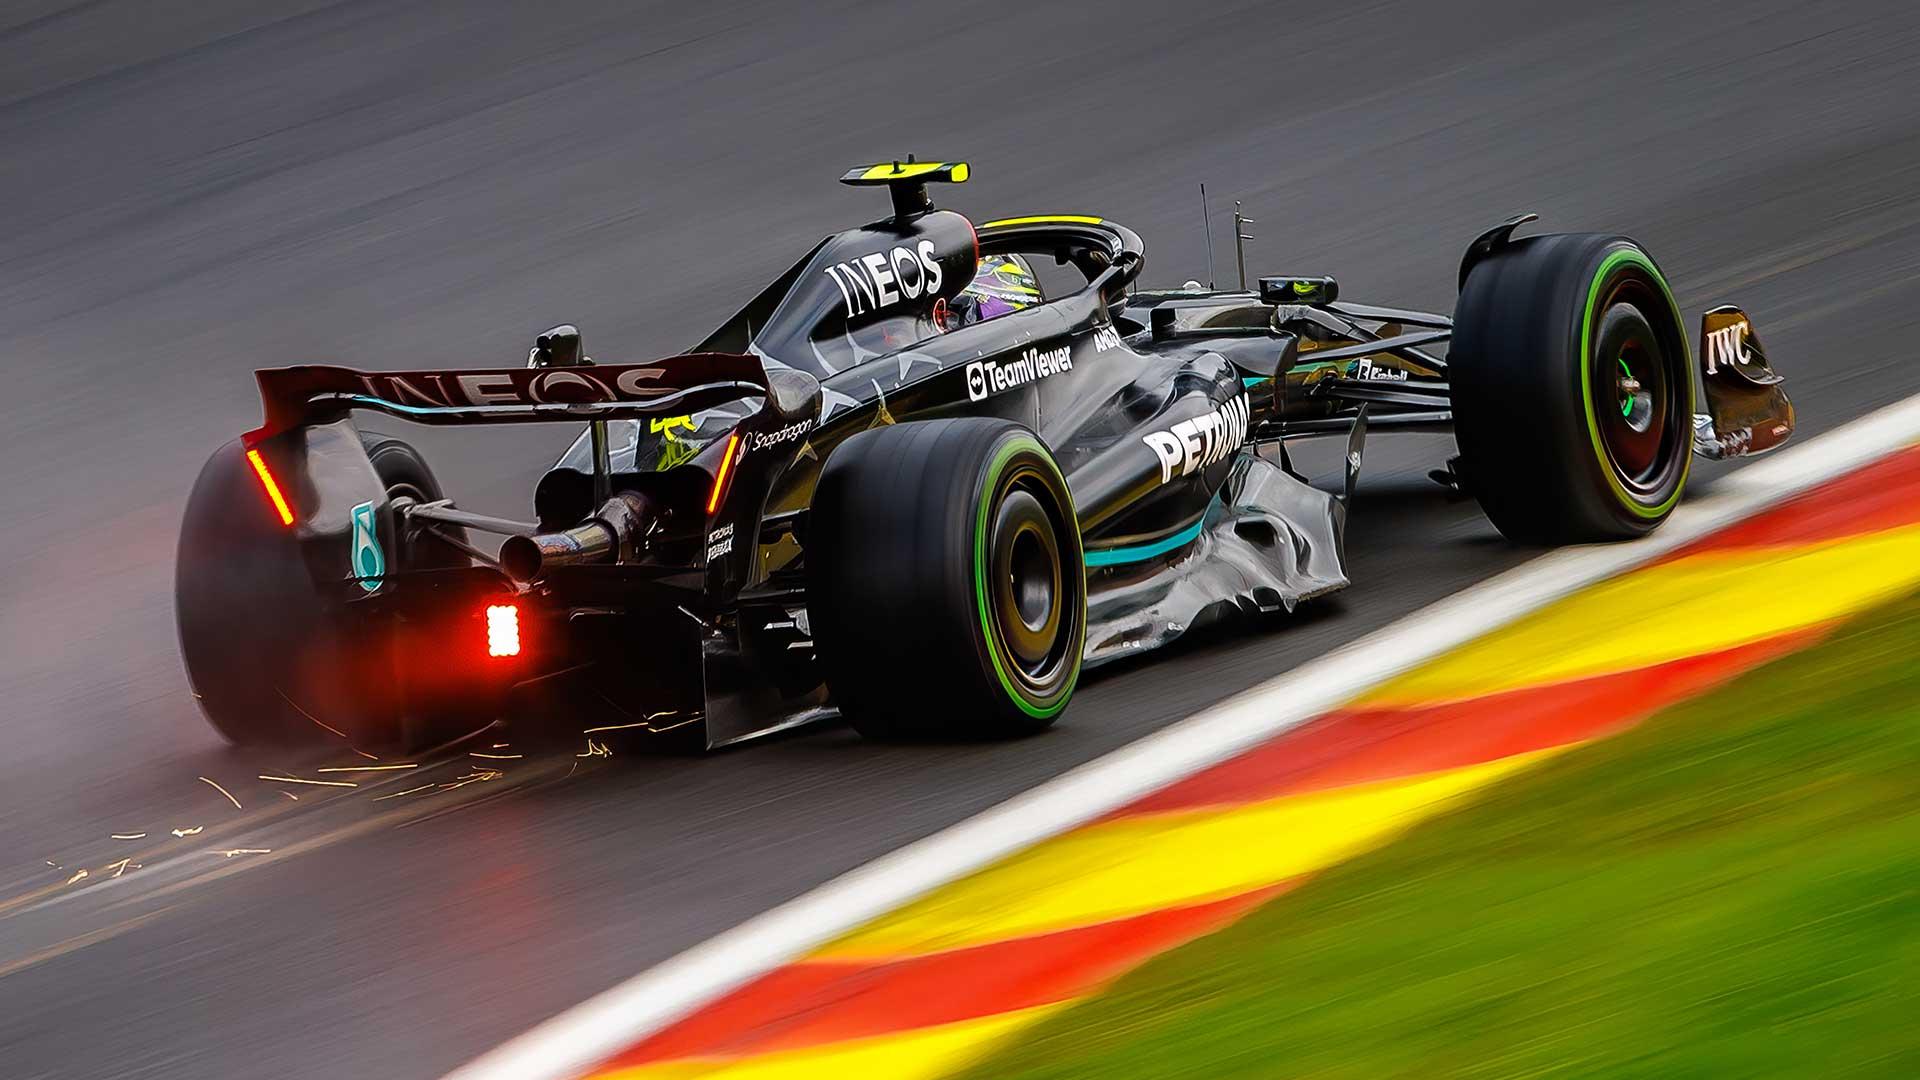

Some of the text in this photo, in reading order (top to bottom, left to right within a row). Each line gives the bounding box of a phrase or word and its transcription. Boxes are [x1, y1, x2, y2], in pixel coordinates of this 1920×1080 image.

[824, 240, 943, 319] INEOS
[985, 346, 1073, 393] TeamViewer
[1707, 321, 1751, 375] IWC
[356, 368, 684, 418] INEOS
